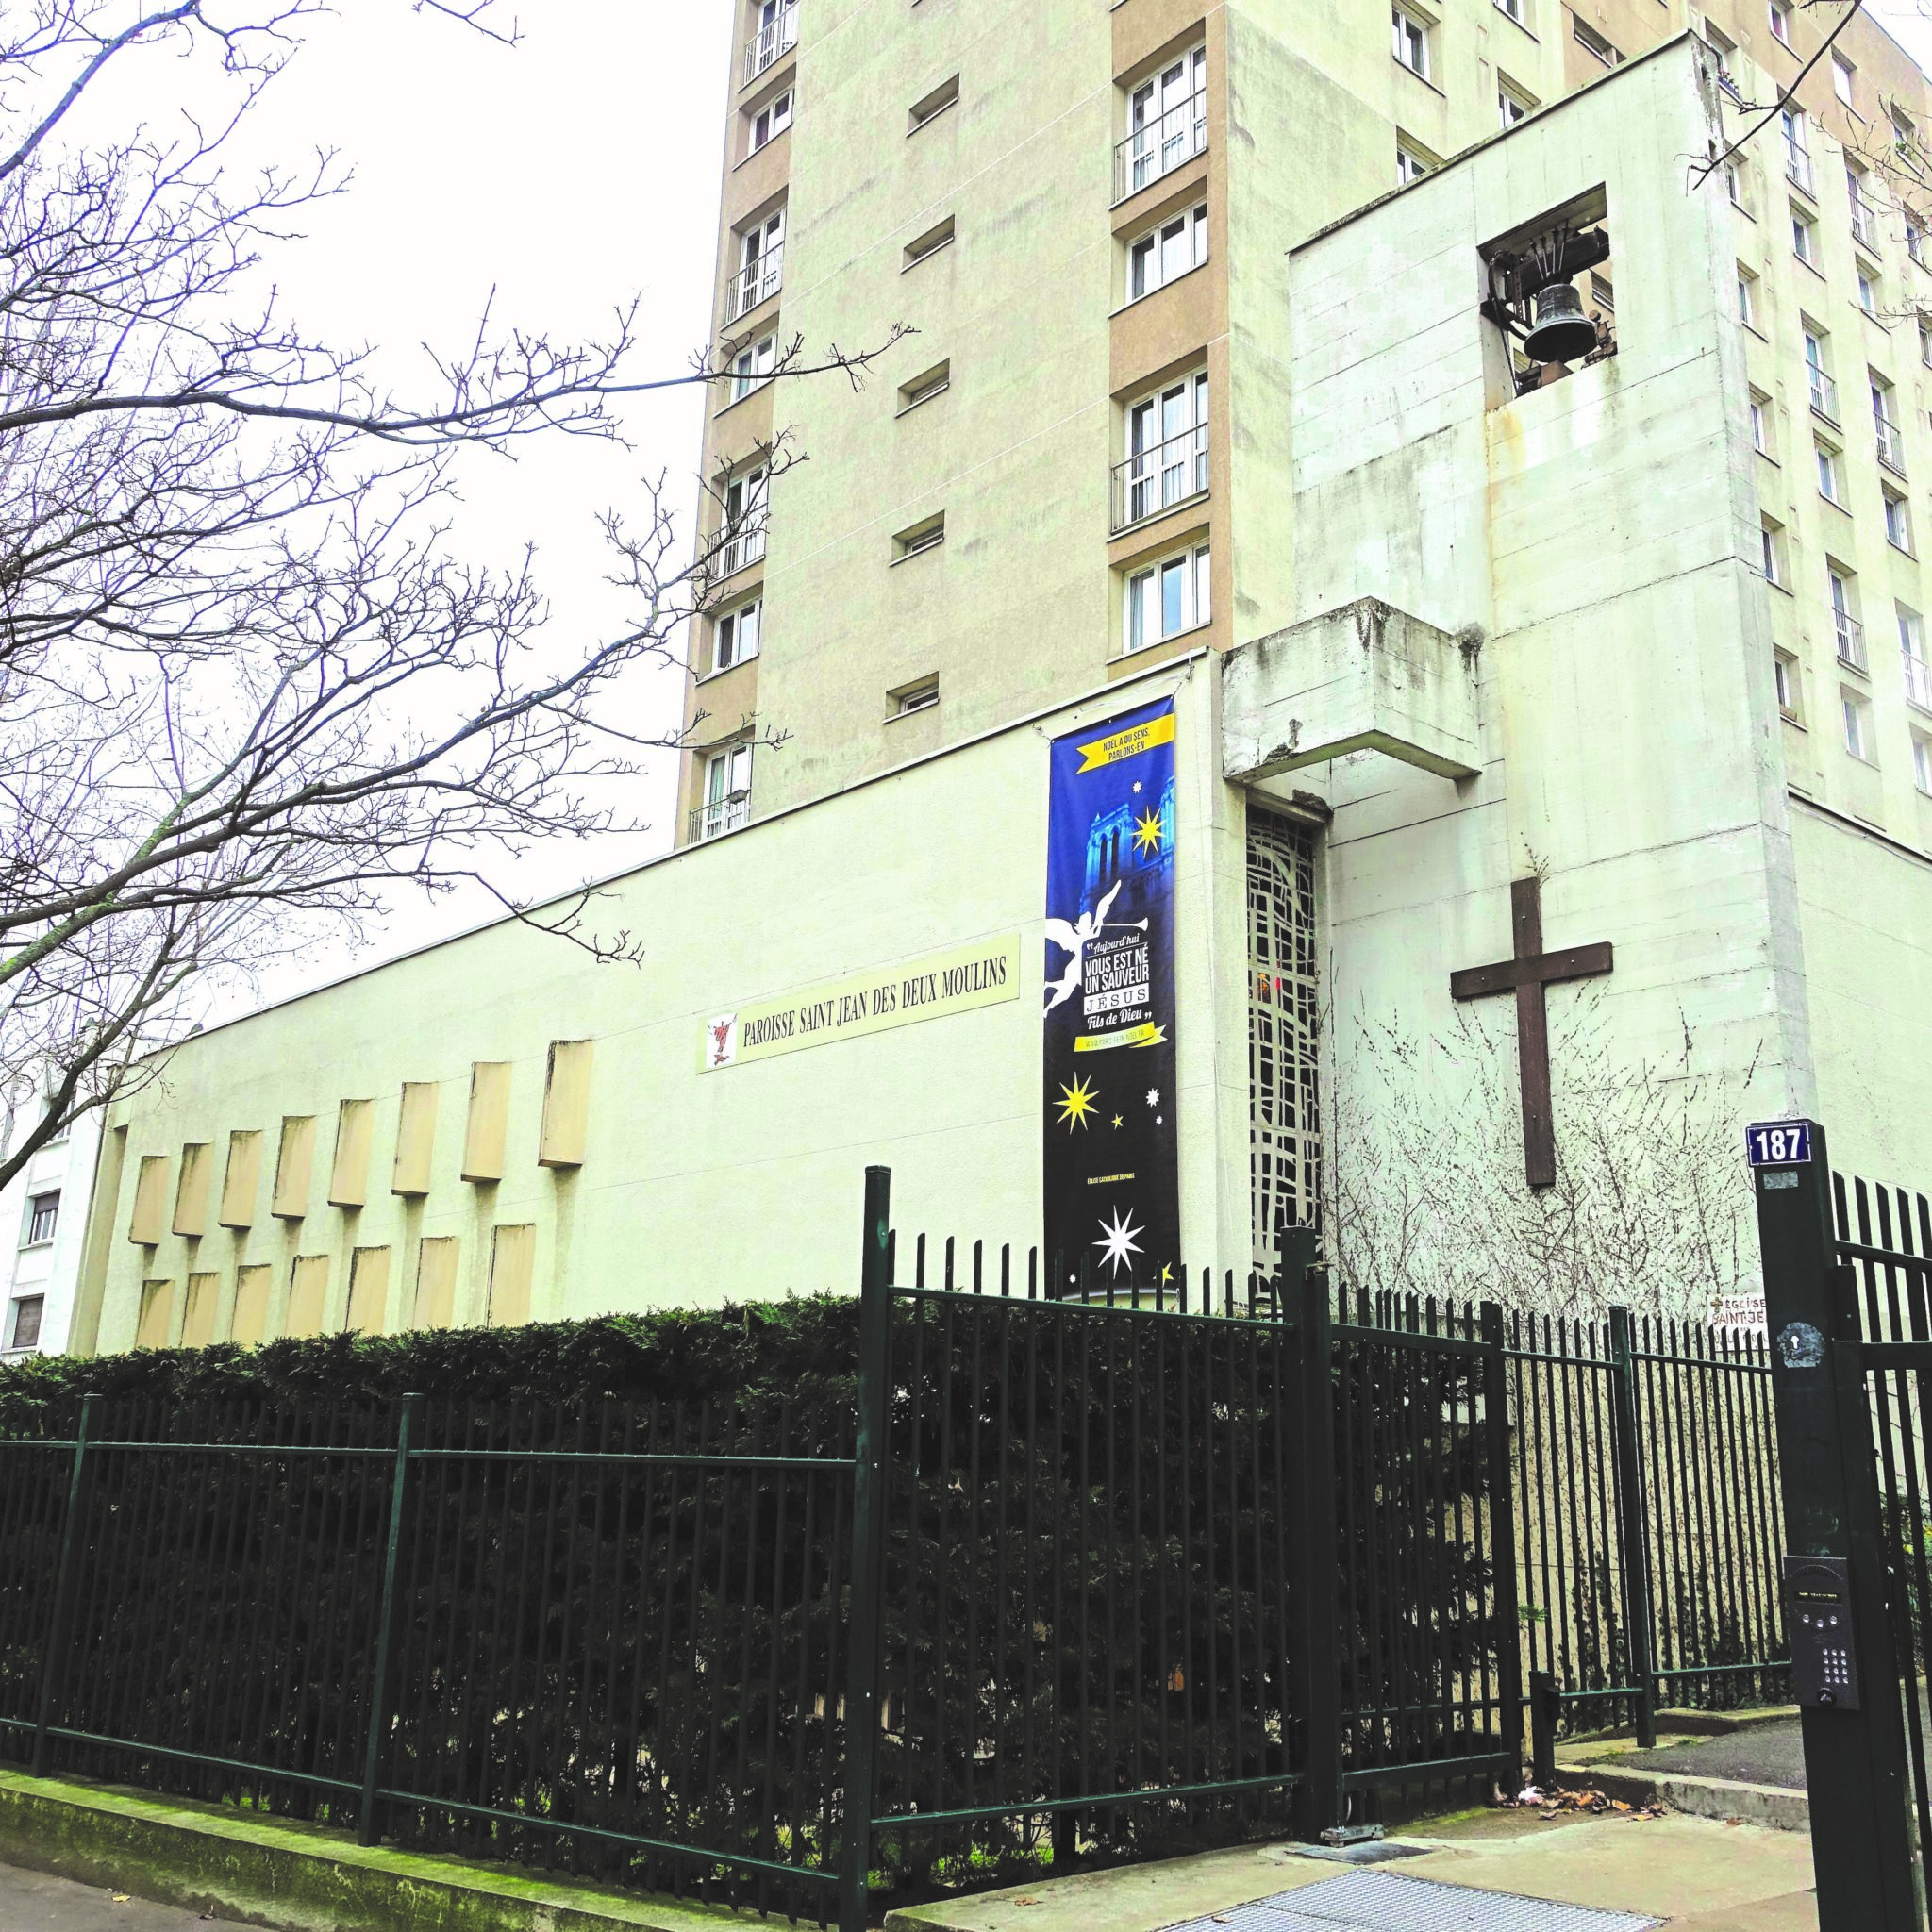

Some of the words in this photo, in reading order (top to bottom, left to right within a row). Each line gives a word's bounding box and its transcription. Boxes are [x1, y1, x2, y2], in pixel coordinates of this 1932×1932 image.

[1085, 956, 1111, 977] VOUS
[1113, 951, 1133, 971] EST
[1135, 943, 1149, 965] NÉ
[1085, 976, 1100, 994] UN
[1101, 963, 1150, 991] SAUVEUR
[743, 1010, 795, 1047] PAROISSE
[799, 1000, 835, 1033] SAINT
[837, 991, 868, 1027] JEAN
[873, 984, 896, 1016] DES
[902, 974, 938, 1008] DEUX
[941, 956, 1007, 999] MOULINS
[1086, 988, 1146, 1012] JÉSUS
[1087, 1015, 1104, 1029] Fils
[1106, 1012, 1117, 1025] de
[1756, 1128, 1801, 1160] 187
[1712, 1311, 1745, 1325] SAINT
